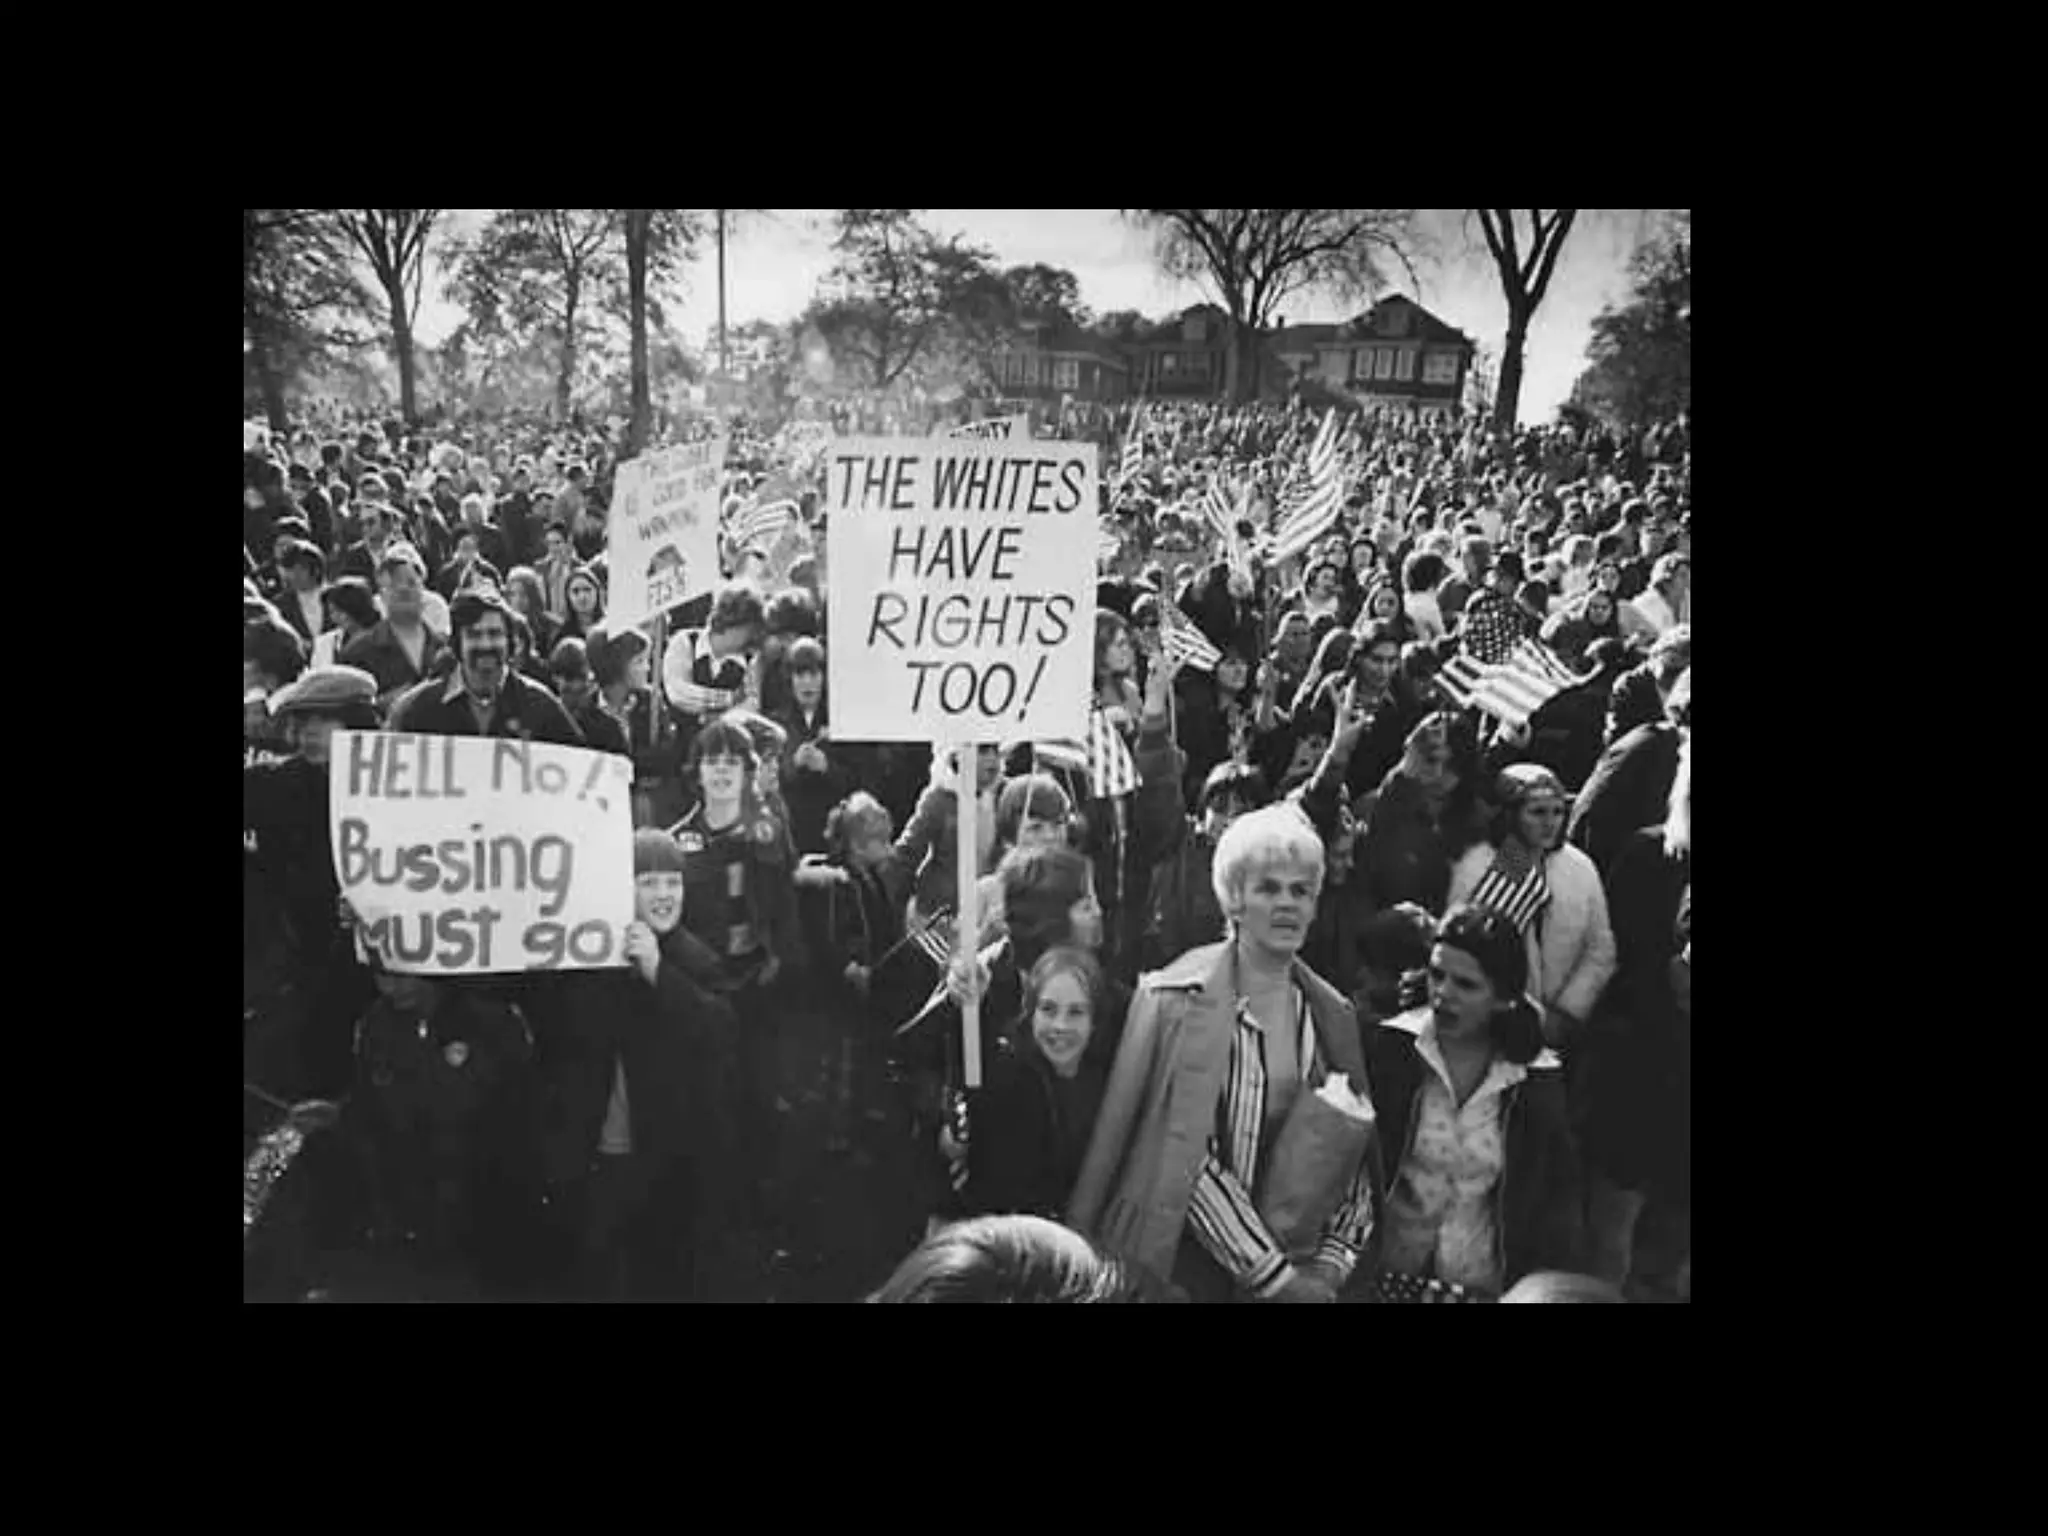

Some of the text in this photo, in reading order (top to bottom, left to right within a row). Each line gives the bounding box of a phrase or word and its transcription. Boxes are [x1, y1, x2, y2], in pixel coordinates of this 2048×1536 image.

[836, 456, 1086, 514] THE WHITES
[889, 525, 1022, 581] HAVE
[867, 593, 1076, 649] RIGHTS
[906, 653, 1048, 722] TOO!
[349, 734, 467, 799] HELL
